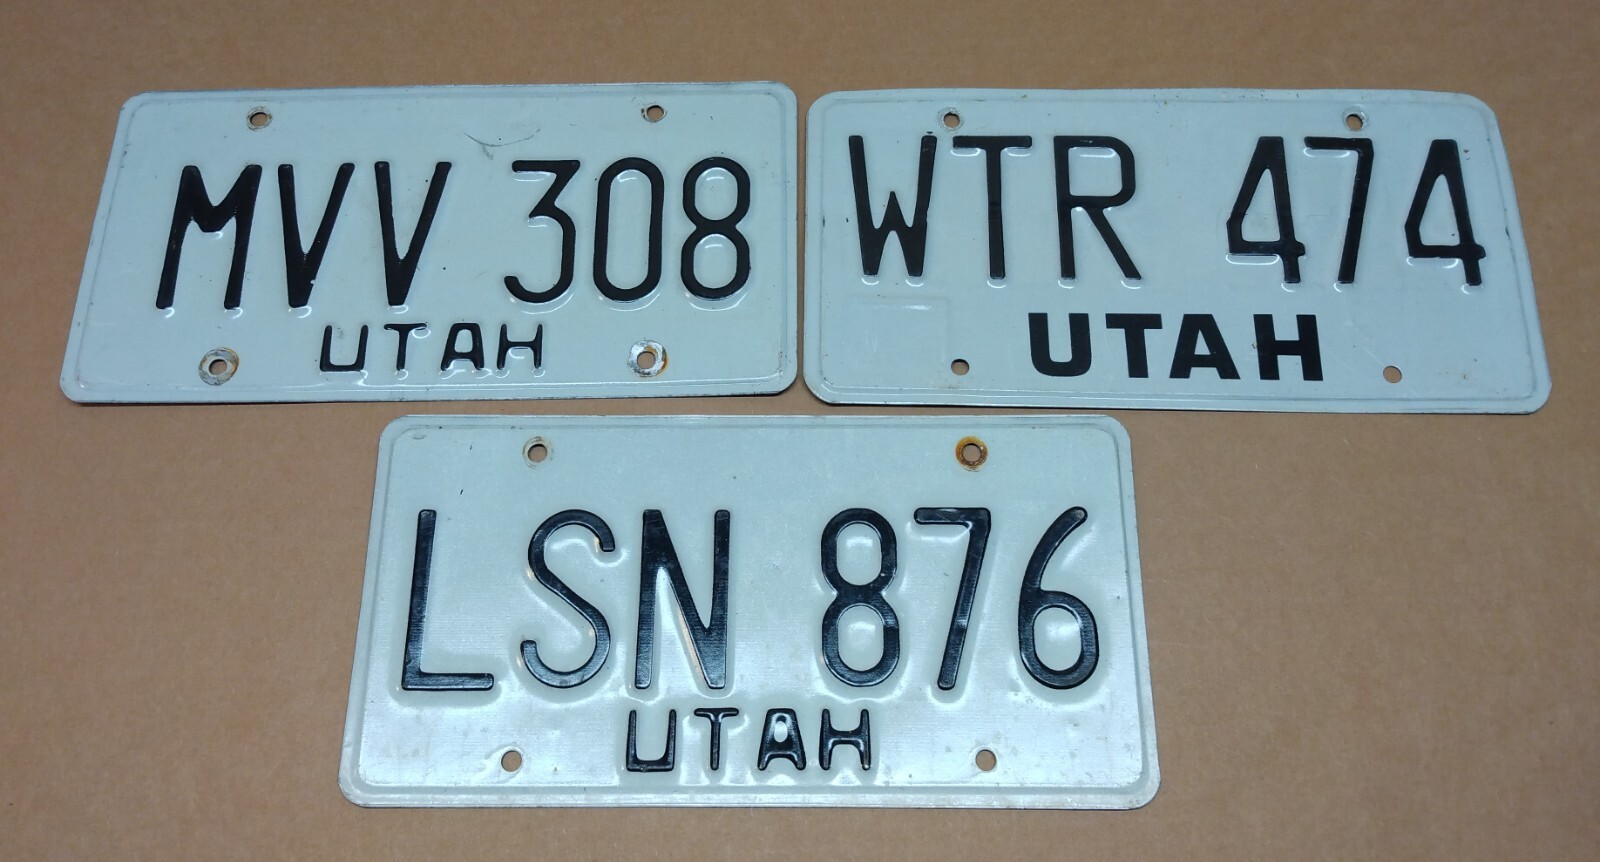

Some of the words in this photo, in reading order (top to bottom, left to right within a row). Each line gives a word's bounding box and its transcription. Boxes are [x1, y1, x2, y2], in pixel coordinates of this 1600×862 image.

[156, 161, 452, 309] MVV
[504, 157, 752, 304] 308
[849, 135, 1142, 281] WTR
[1226, 136, 1486, 286] 474
[320, 323, 543, 372] UTAH
[1029, 313, 1323, 381] UTAH
[401, 508, 731, 691] LSN
[821, 507, 1100, 690] 876
[626, 708, 872, 773] UTAH
